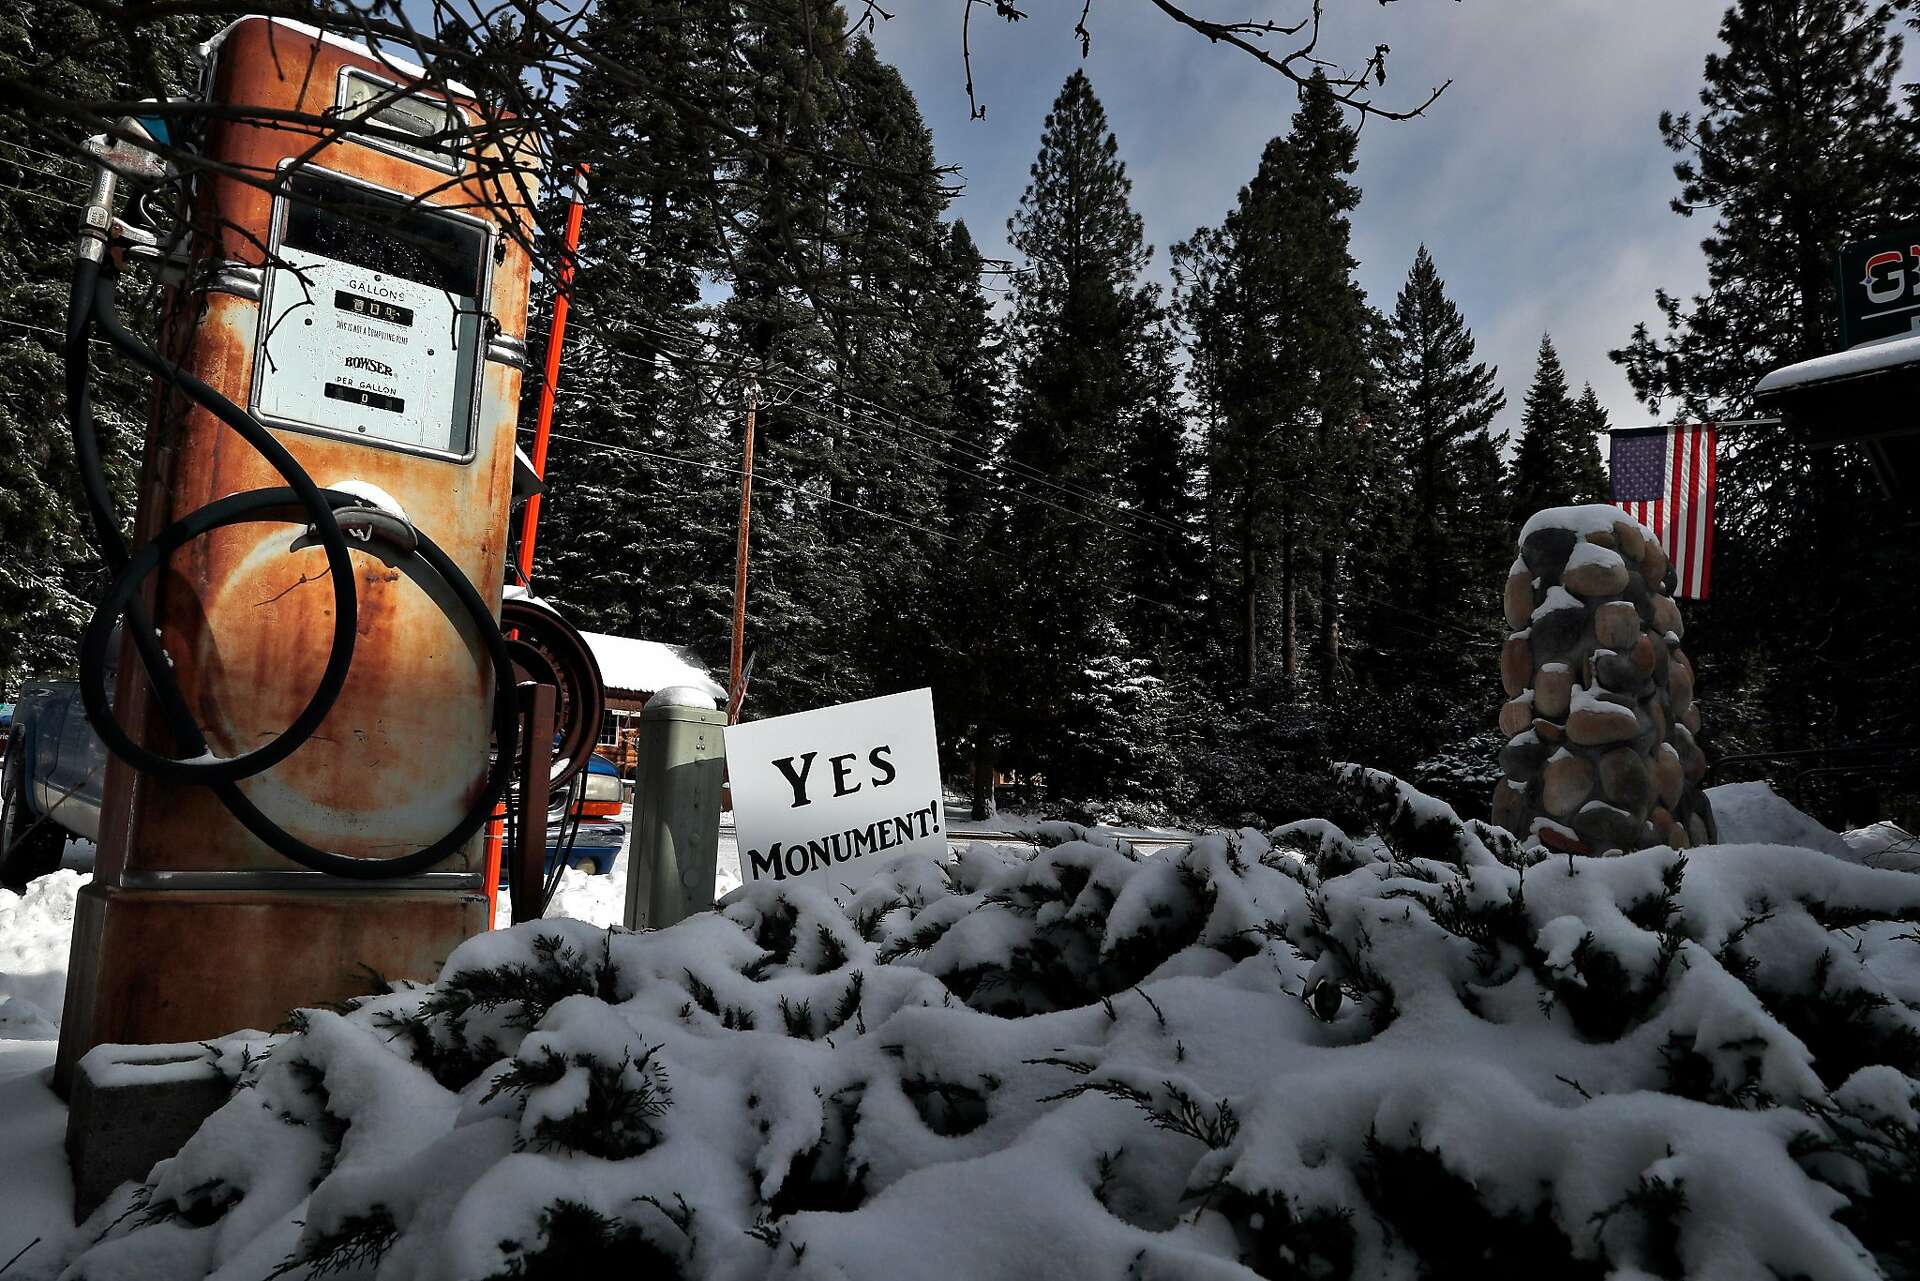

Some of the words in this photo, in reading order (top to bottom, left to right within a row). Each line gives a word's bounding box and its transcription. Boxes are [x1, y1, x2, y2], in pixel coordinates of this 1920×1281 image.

[349, 279, 405, 302] GALLONS
[1859, 245, 1920, 303] G
[336, 376, 354, 386] PER
[359, 381, 397, 395] GALLON
[345, 356, 393, 377] BOWSER
[771, 744, 896, 808] YES
[747, 799, 940, 881] MONUMENT!
